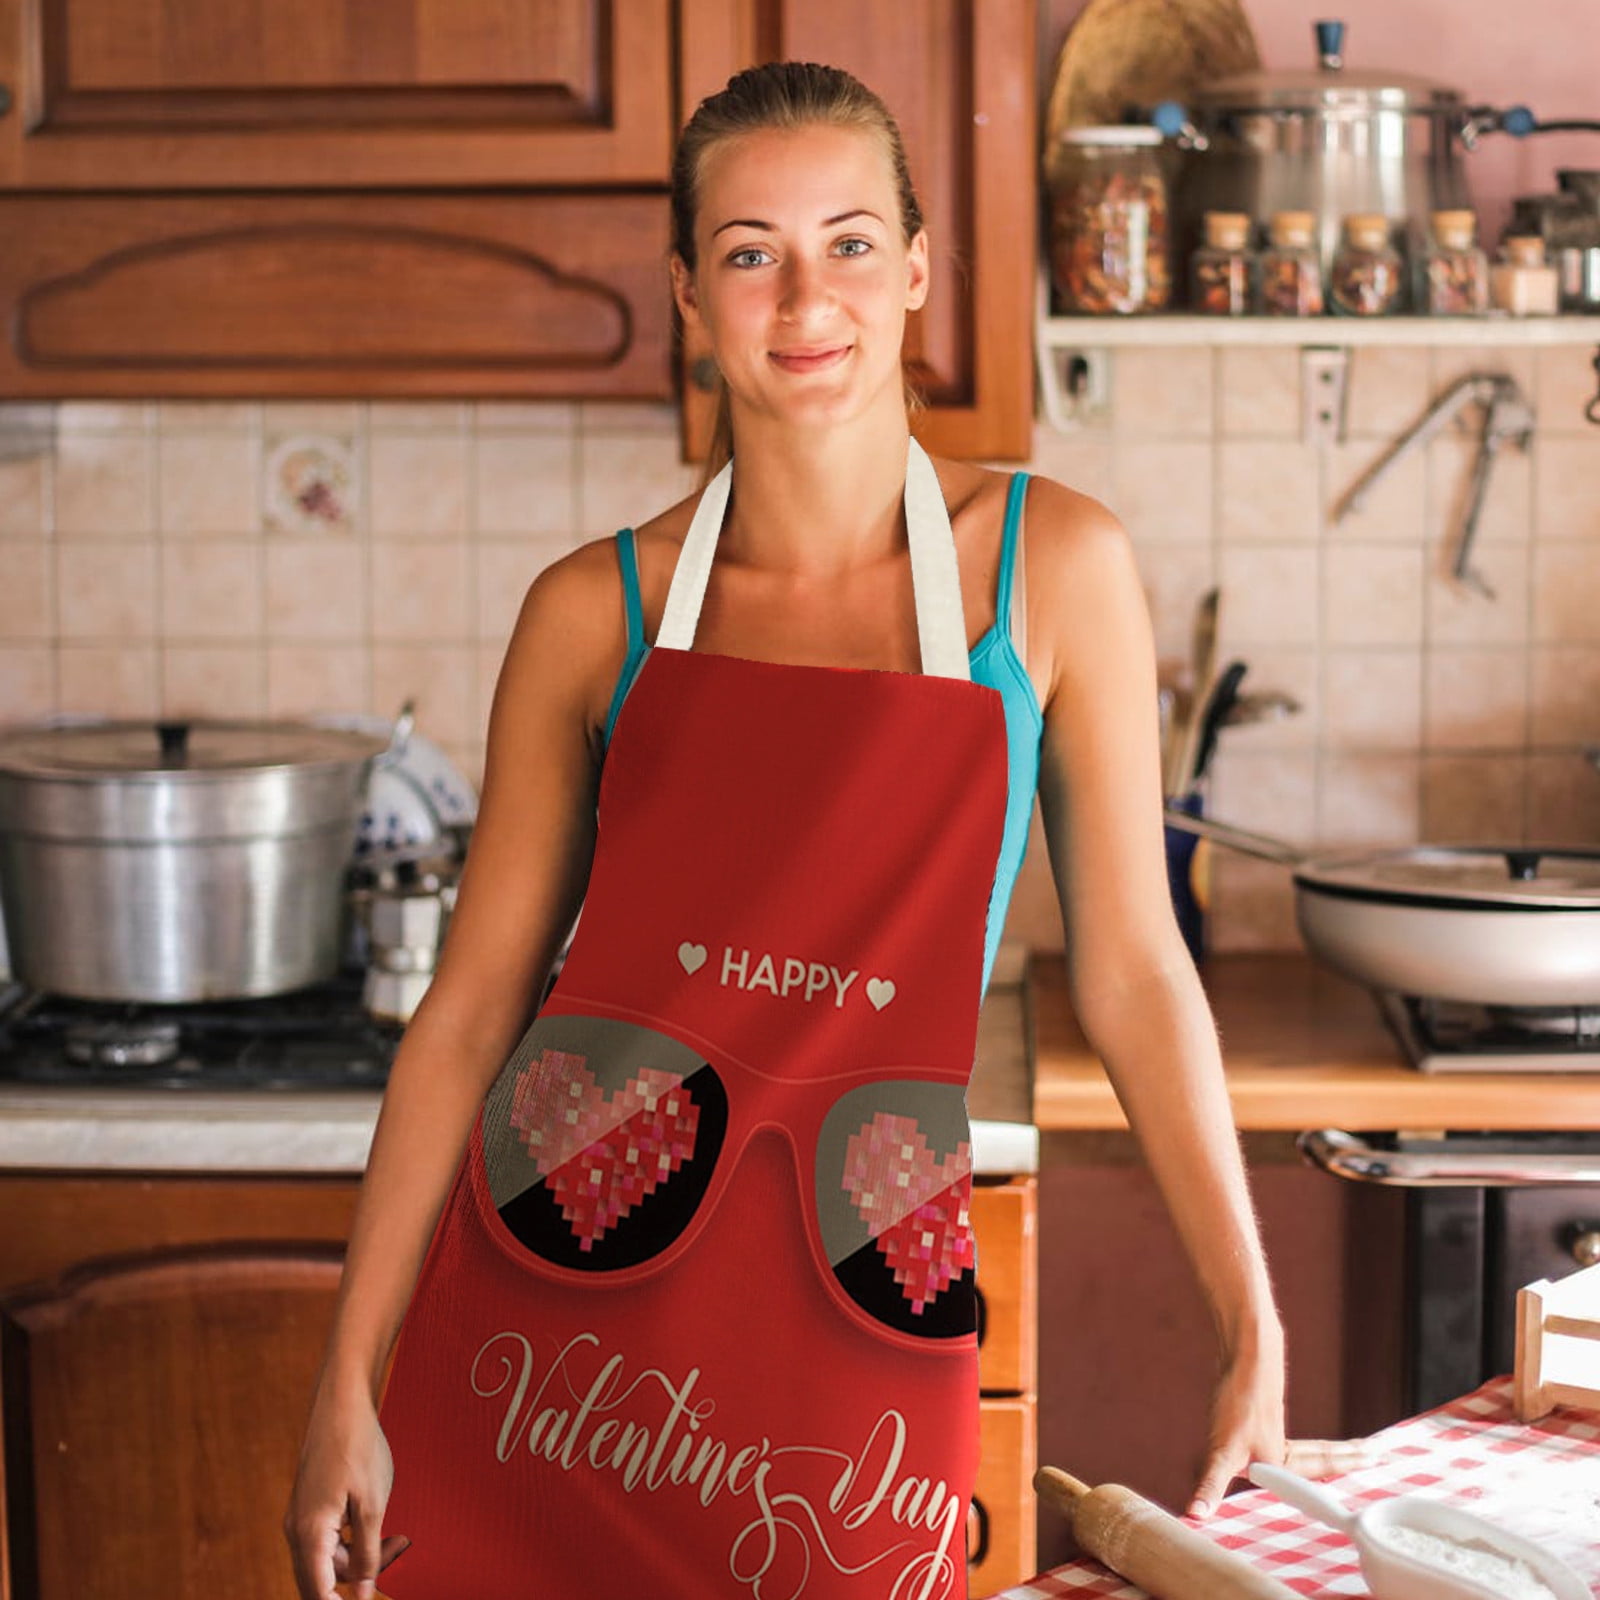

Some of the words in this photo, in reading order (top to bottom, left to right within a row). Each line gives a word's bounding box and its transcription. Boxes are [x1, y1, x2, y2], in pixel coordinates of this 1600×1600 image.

[720, 946, 859, 1008] HAPPY
[471, 1331, 810, 1600] Valentine's
[773, 1409, 959, 1600] Day
